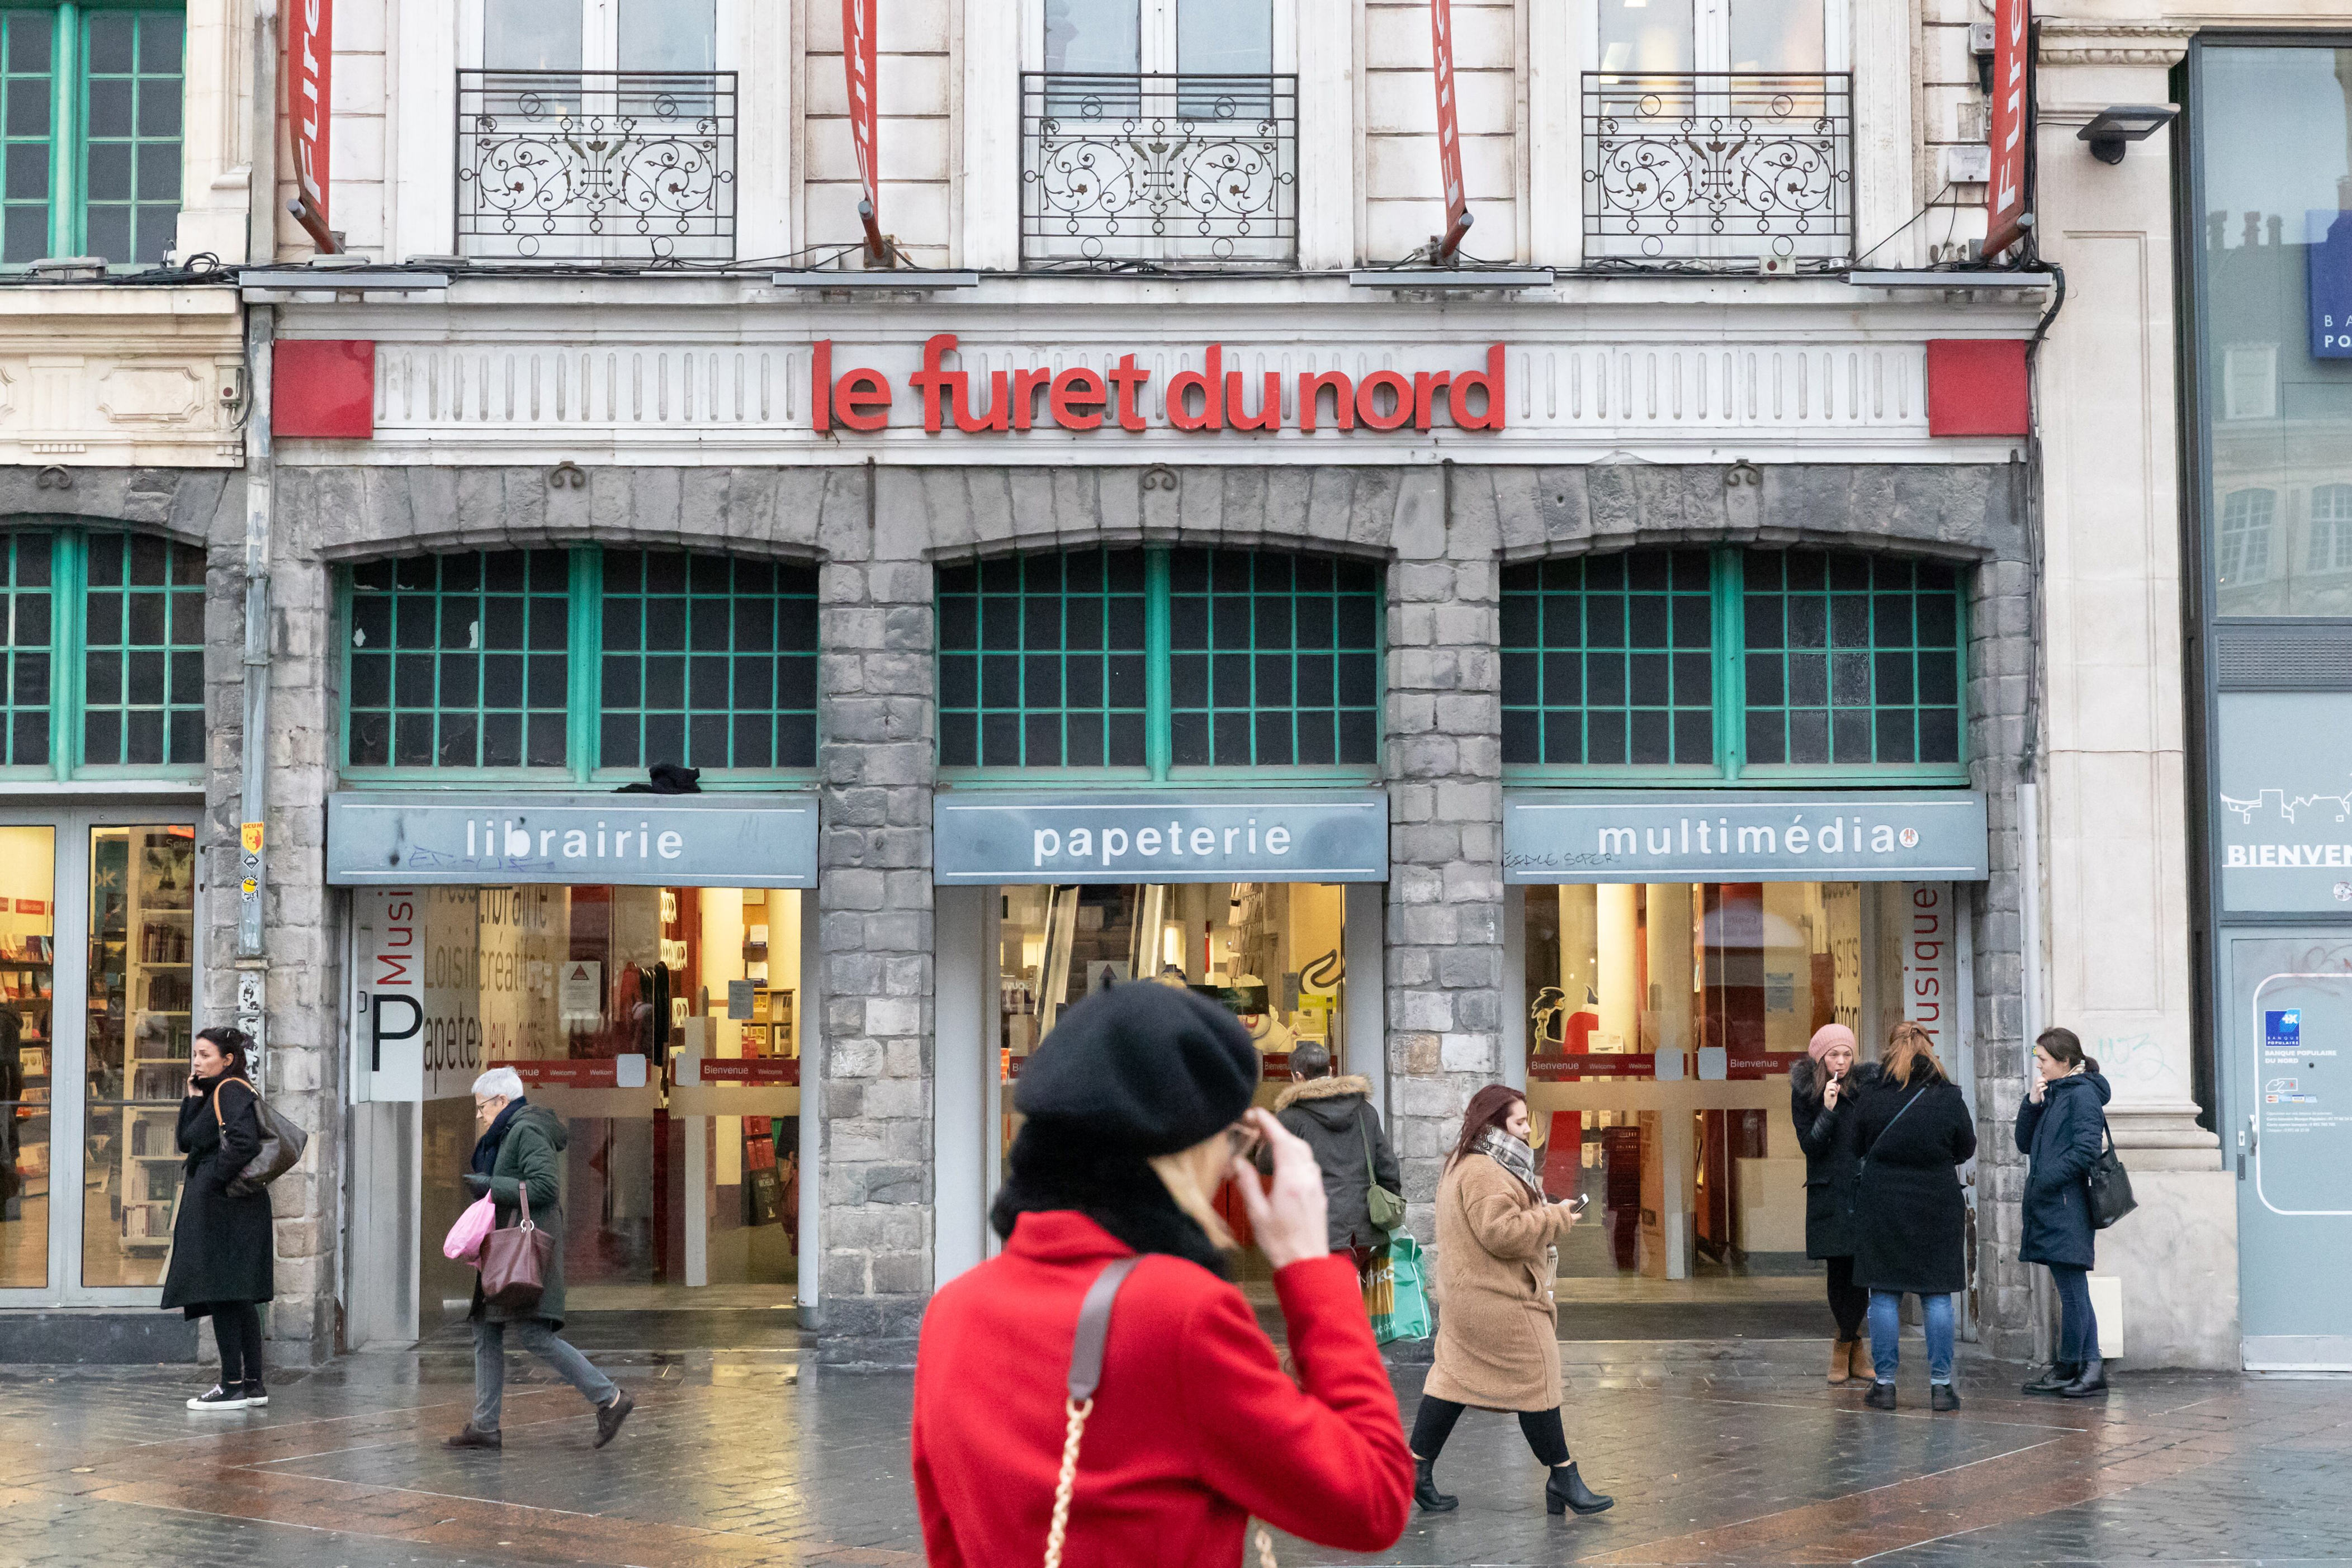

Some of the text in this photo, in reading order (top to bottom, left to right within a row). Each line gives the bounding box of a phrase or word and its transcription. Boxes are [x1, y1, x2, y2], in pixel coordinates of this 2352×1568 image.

[812, 334, 1506, 433] le furet du nord
[467, 819, 683, 859] librairie
[1034, 818, 1292, 866] papeterie
[1598, 814, 1895, 855] multimédia
[704, 1065, 749, 1074] Bienvenue
[1531, 1061, 1579, 1070] Bienvenue
[1730, 1059, 1778, 1068] Bienvenue
